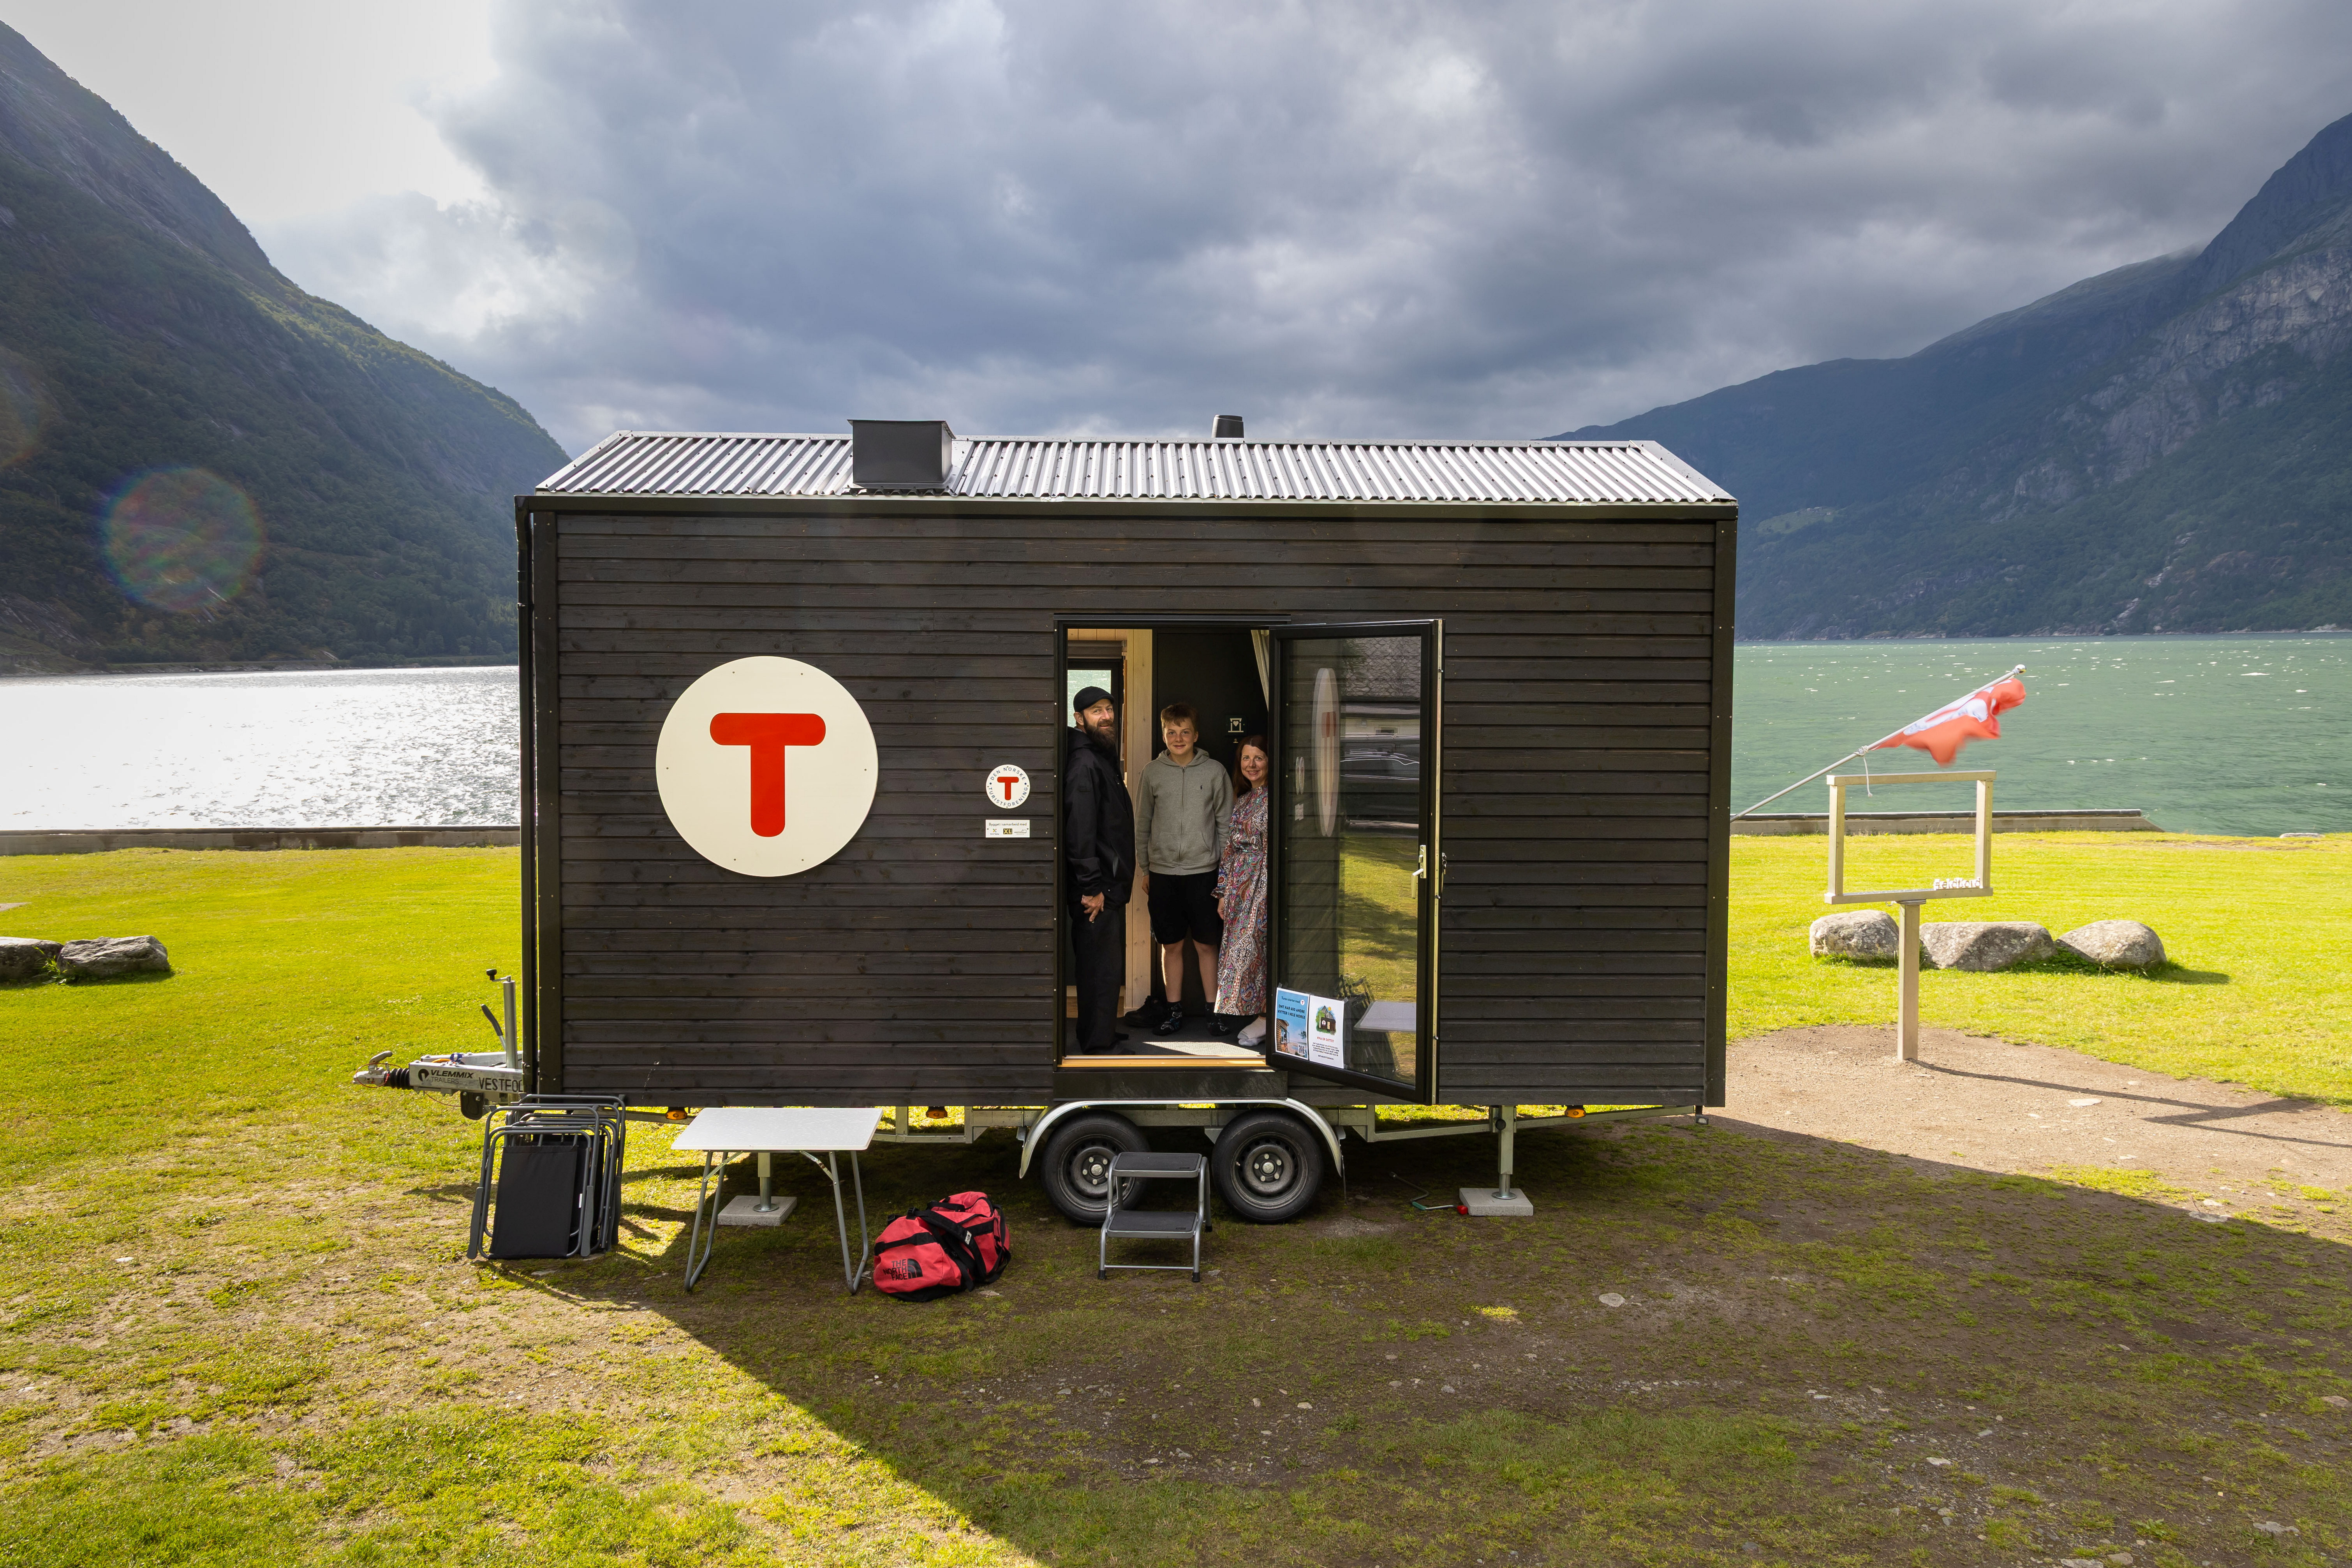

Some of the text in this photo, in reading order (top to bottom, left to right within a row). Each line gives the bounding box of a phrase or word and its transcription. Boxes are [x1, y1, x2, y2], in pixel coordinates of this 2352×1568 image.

[710, 713, 826, 837] T
[990, 767, 1026, 780] DEN NORSKE
[997, 777, 1019, 800] T
[989, 787, 1028, 807] TURISTFORENING
[431, 1070, 474, 1078] VLEMMIX
[883, 1266, 907, 1275] NORTH
